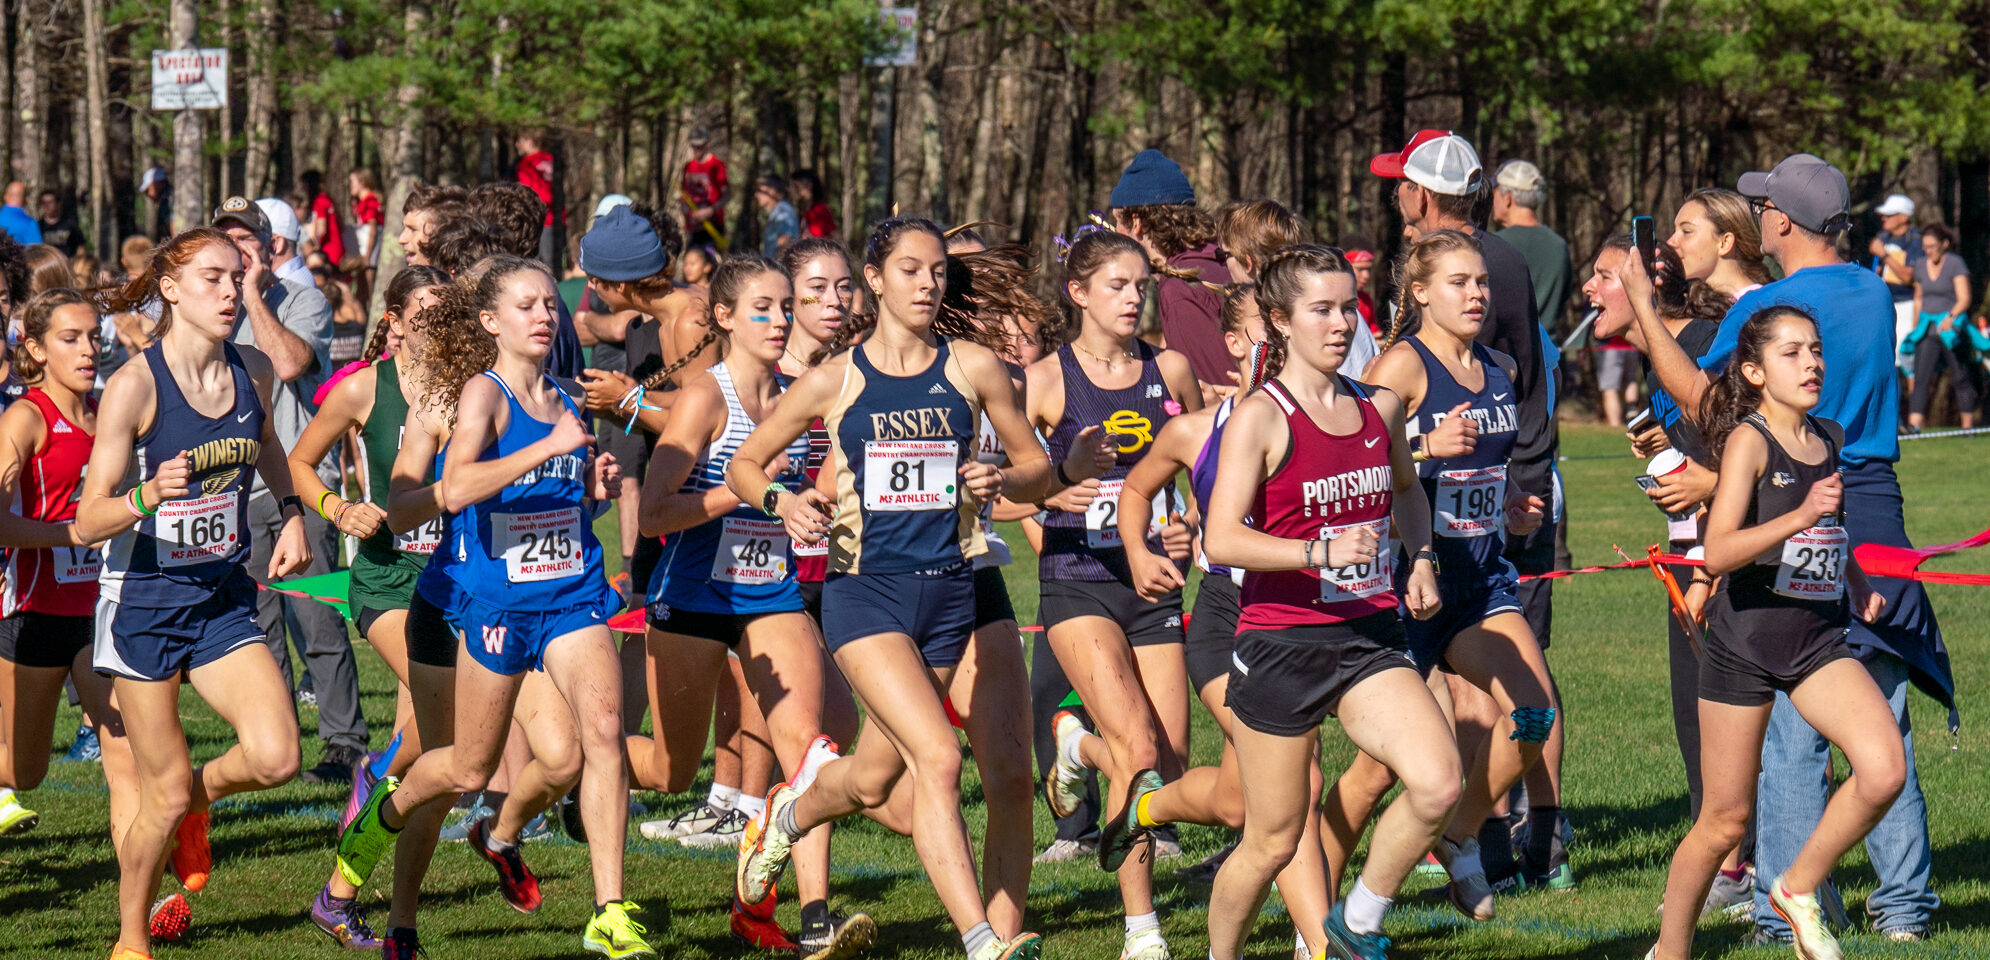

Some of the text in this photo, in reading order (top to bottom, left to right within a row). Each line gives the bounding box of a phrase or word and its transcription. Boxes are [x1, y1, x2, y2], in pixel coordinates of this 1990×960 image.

[869, 407, 954, 441] ESSEX
[889, 460, 925, 492] 81
[183, 498, 209, 507] ENGLAND
[210, 494, 228, 503] CROSS
[190, 501, 235, 516] CHAMPIONSHIPS
[879, 493, 940, 504] MF ATHLETIC
[1450, 485, 1497, 519] 198
[171, 513, 226, 549] 166
[1447, 522, 1461, 531] MF
[171, 551, 185, 559] MF
[186, 543, 226, 558] ATHLETIC
[520, 528, 571, 563] 245
[738, 538, 772, 567] 48
[521, 560, 573, 574] MF ATHLETIC
[725, 567, 775, 578] MF ATHLETIC
[1791, 547, 1841, 581] 233
[1336, 577, 1384, 594] MF ATHLETIC
[482, 624, 507, 655] W
